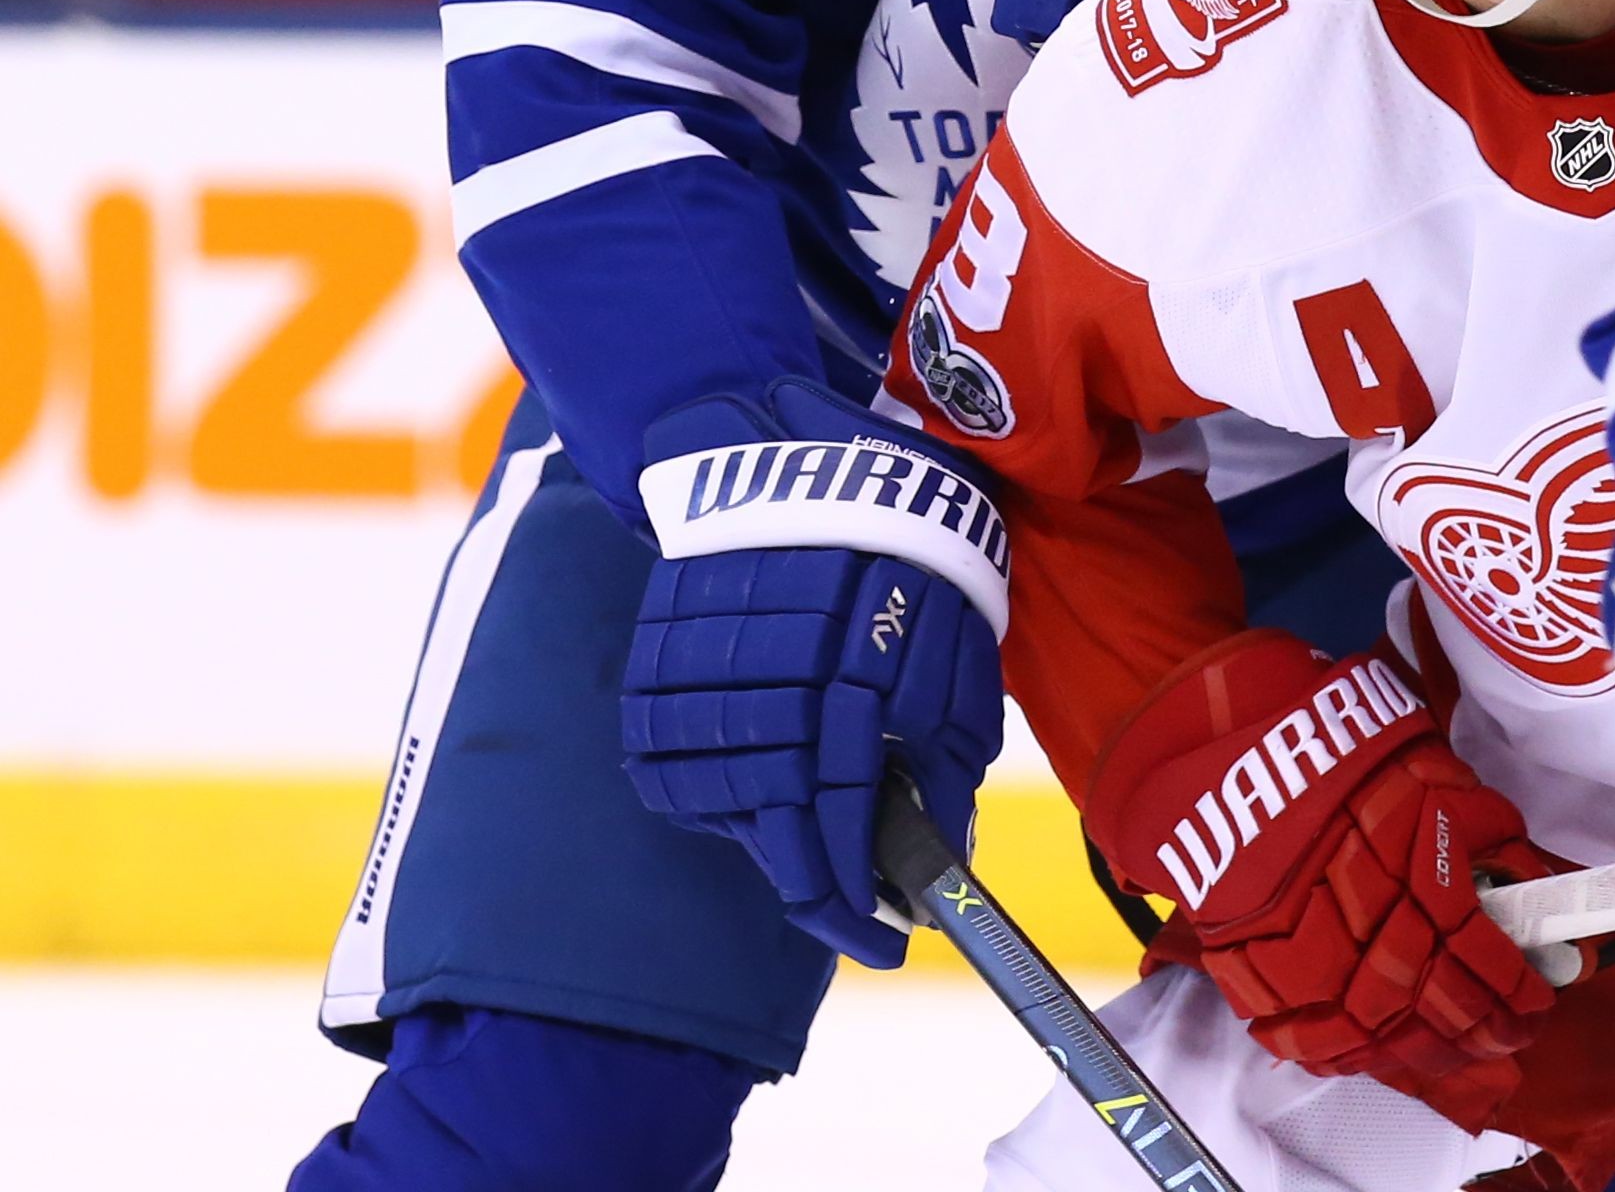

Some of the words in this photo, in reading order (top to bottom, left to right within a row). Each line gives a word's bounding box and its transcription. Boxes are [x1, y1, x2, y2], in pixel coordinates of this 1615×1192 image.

[1567, 136, 1604, 176] NHL
[1292, 278, 1438, 446] A
[1155, 658, 1427, 911] WARRIO
[1436, 808, 1450, 888] COVERT
